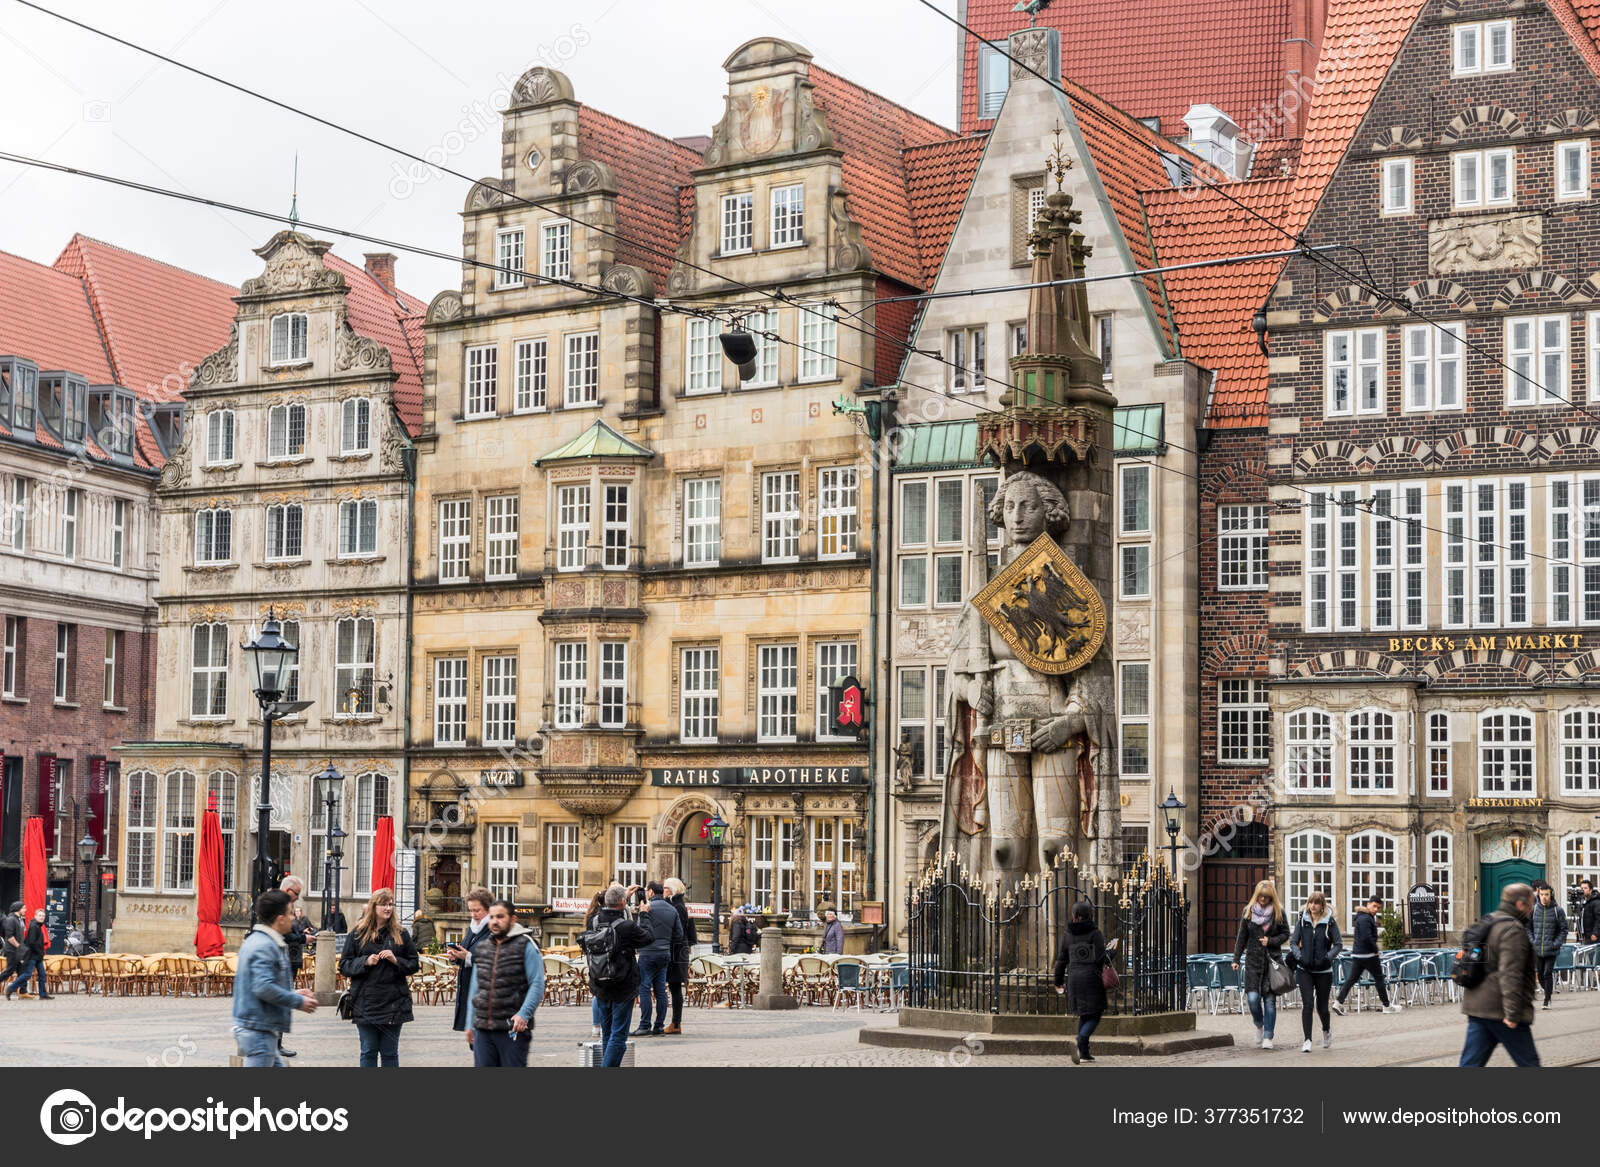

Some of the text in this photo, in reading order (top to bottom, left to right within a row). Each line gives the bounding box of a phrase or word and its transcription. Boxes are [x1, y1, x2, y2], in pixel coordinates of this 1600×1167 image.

[1388, 634, 1583, 652] BECK's AM MARKT
[663, 768, 850, 784] RATHS APOTHEKE
[1468, 798, 1544, 807] RESTAURANT
